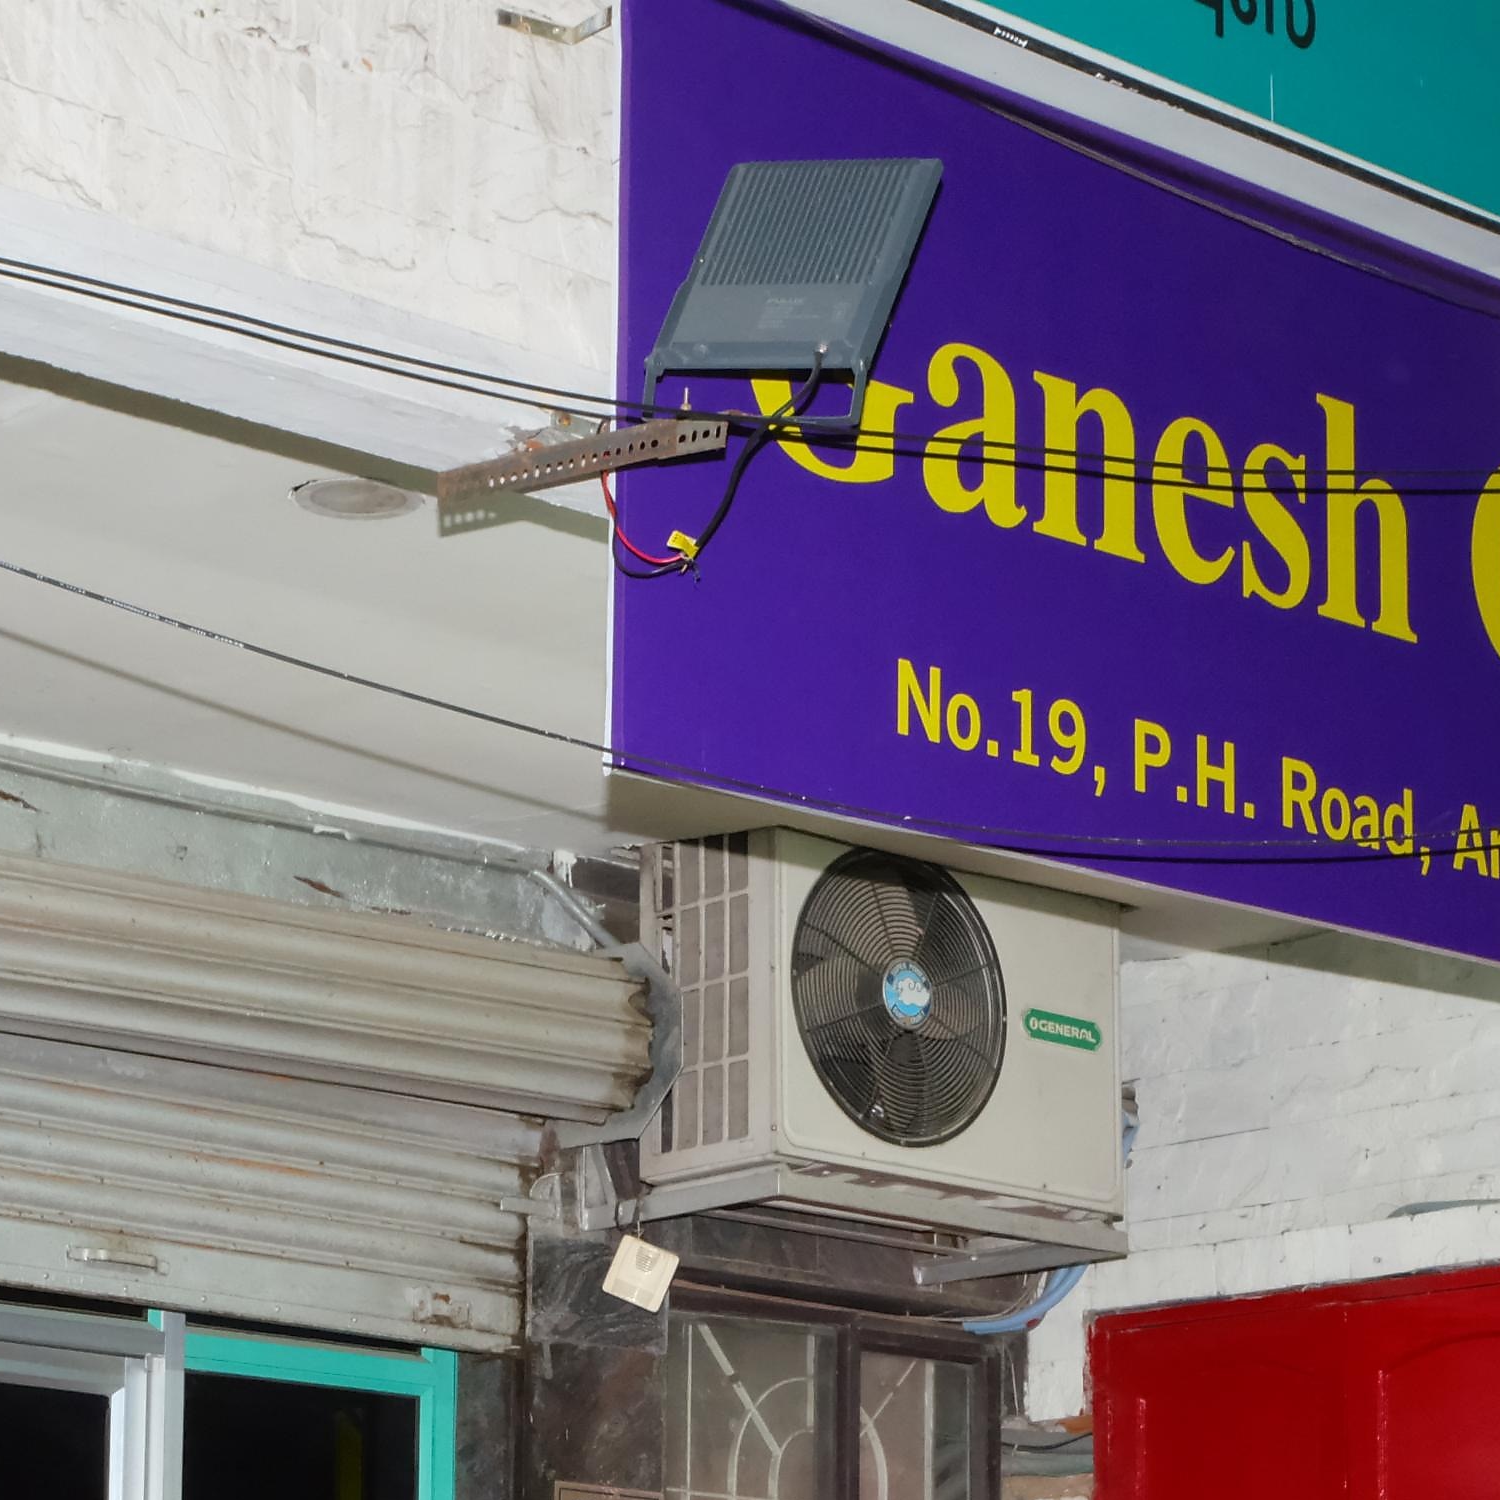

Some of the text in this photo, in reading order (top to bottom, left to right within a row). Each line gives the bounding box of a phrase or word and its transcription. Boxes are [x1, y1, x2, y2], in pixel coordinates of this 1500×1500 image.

[897, 658, 1107, 797] No.19,
[1134, 717, 1256, 819] P.H.
[1281, 755, 1431, 876] Road,
